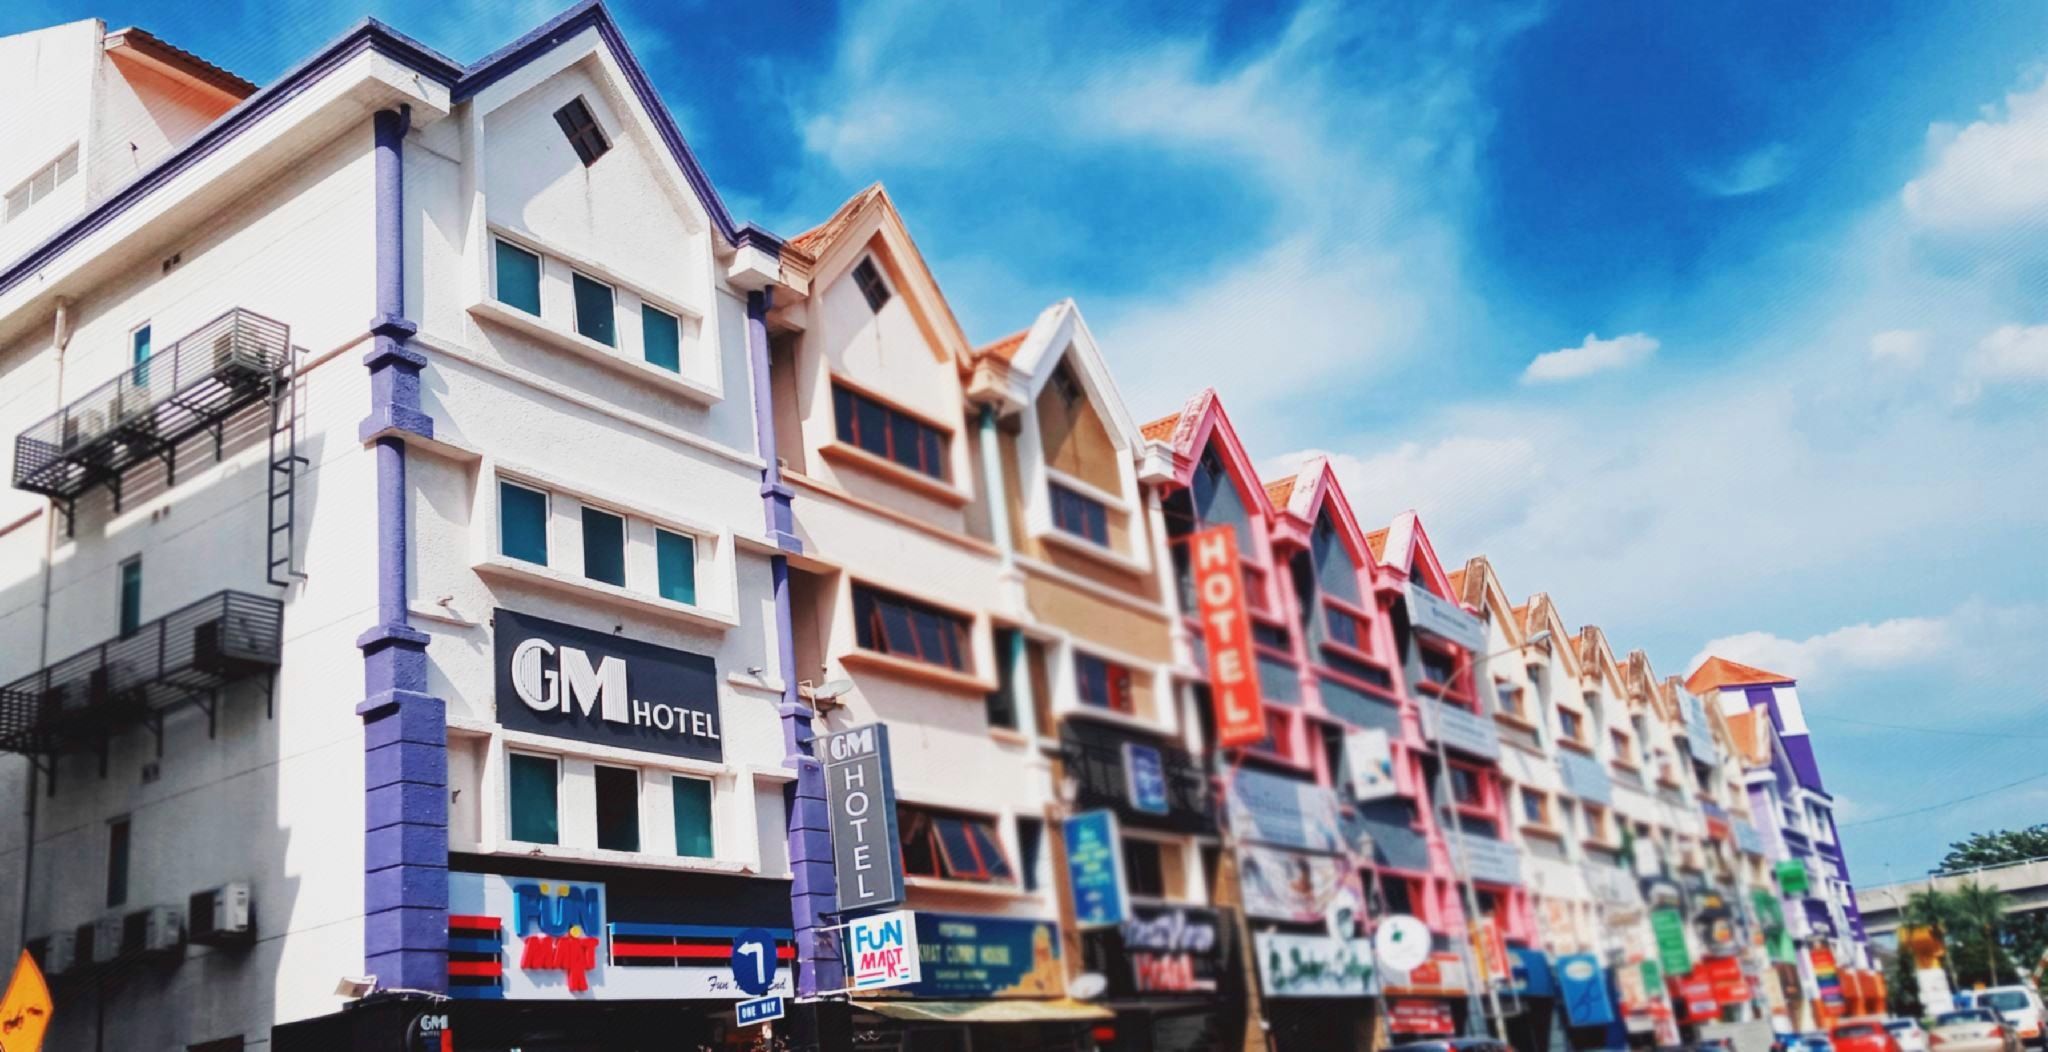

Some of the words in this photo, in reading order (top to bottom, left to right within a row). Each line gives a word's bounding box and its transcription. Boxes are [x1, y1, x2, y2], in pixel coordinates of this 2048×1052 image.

[1198, 533, 1250, 723] HOTEL
[511, 638, 629, 724] GM
[633, 700, 720, 739] HOTEL
[831, 728, 874, 760] GM
[844, 764, 874, 899] HOTEL
[855, 920, 903, 953] FUN
[520, 935, 600, 992] MART
[860, 948, 903, 978] MART
[707, 975, 729, 992] Fun
[420, 1014, 449, 1030] GM
[741, 1006, 756, 1019] ONE
[761, 1001, 777, 1014] WAY
